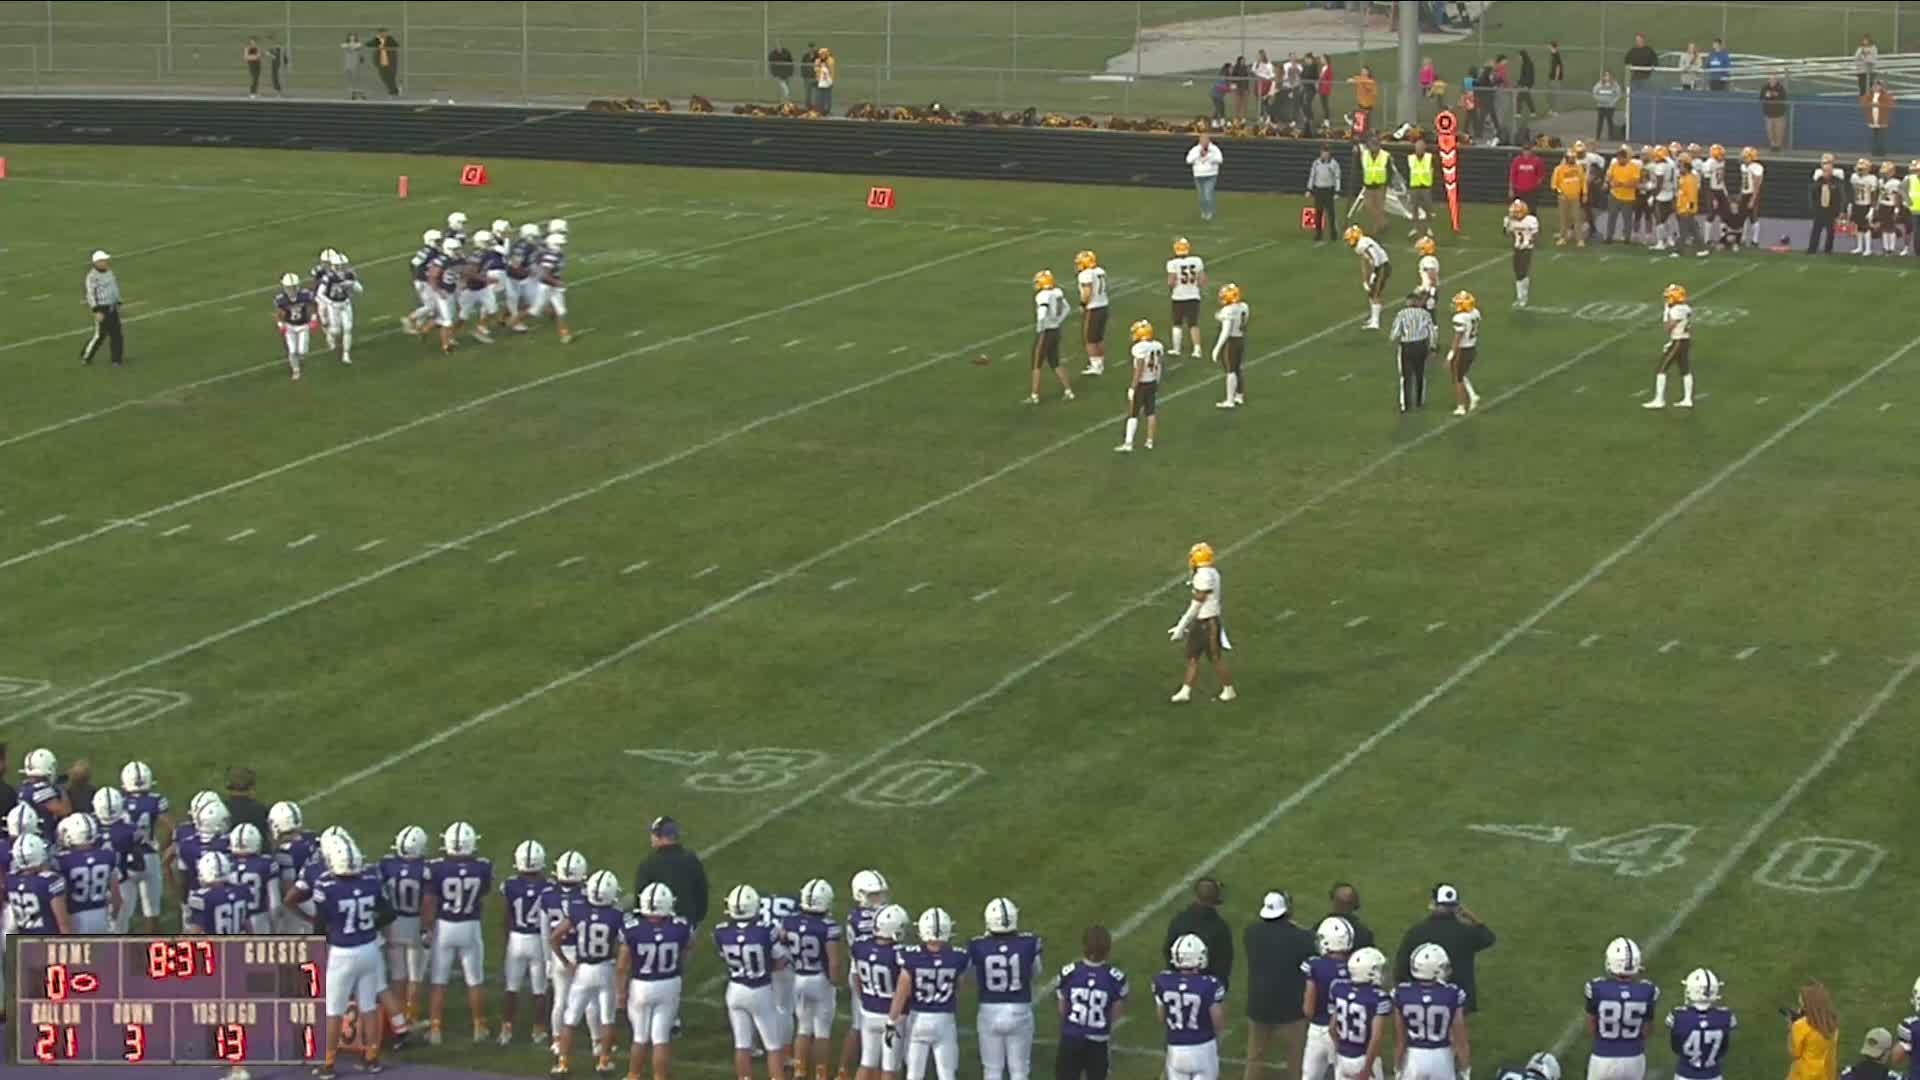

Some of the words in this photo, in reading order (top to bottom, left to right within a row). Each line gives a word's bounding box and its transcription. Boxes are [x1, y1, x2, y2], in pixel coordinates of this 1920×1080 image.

[870, 189, 887, 206] 10
[1180, 264, 1197, 285] 55
[69, 864, 110, 902] 38
[385, 877, 421, 913] 10
[441, 876, 481, 914] 97
[338, 895, 376, 934] 75
[512, 895, 543, 928] 14
[577, 920, 610, 958] 18
[637, 942, 679, 974] 70
[722, 943, 766, 979] 50
[857, 959, 894, 999] 90
[984, 953, 1023, 993] 61
[915, 967, 956, 1004] 55
[1068, 987, 1108, 1028] 58
[1162, 991, 1201, 1030] 37
[1403, 1004, 1451, 1042] 30
[1598, 1000, 1648, 1039] 85
[1683, 1029, 1724, 1068] 47
